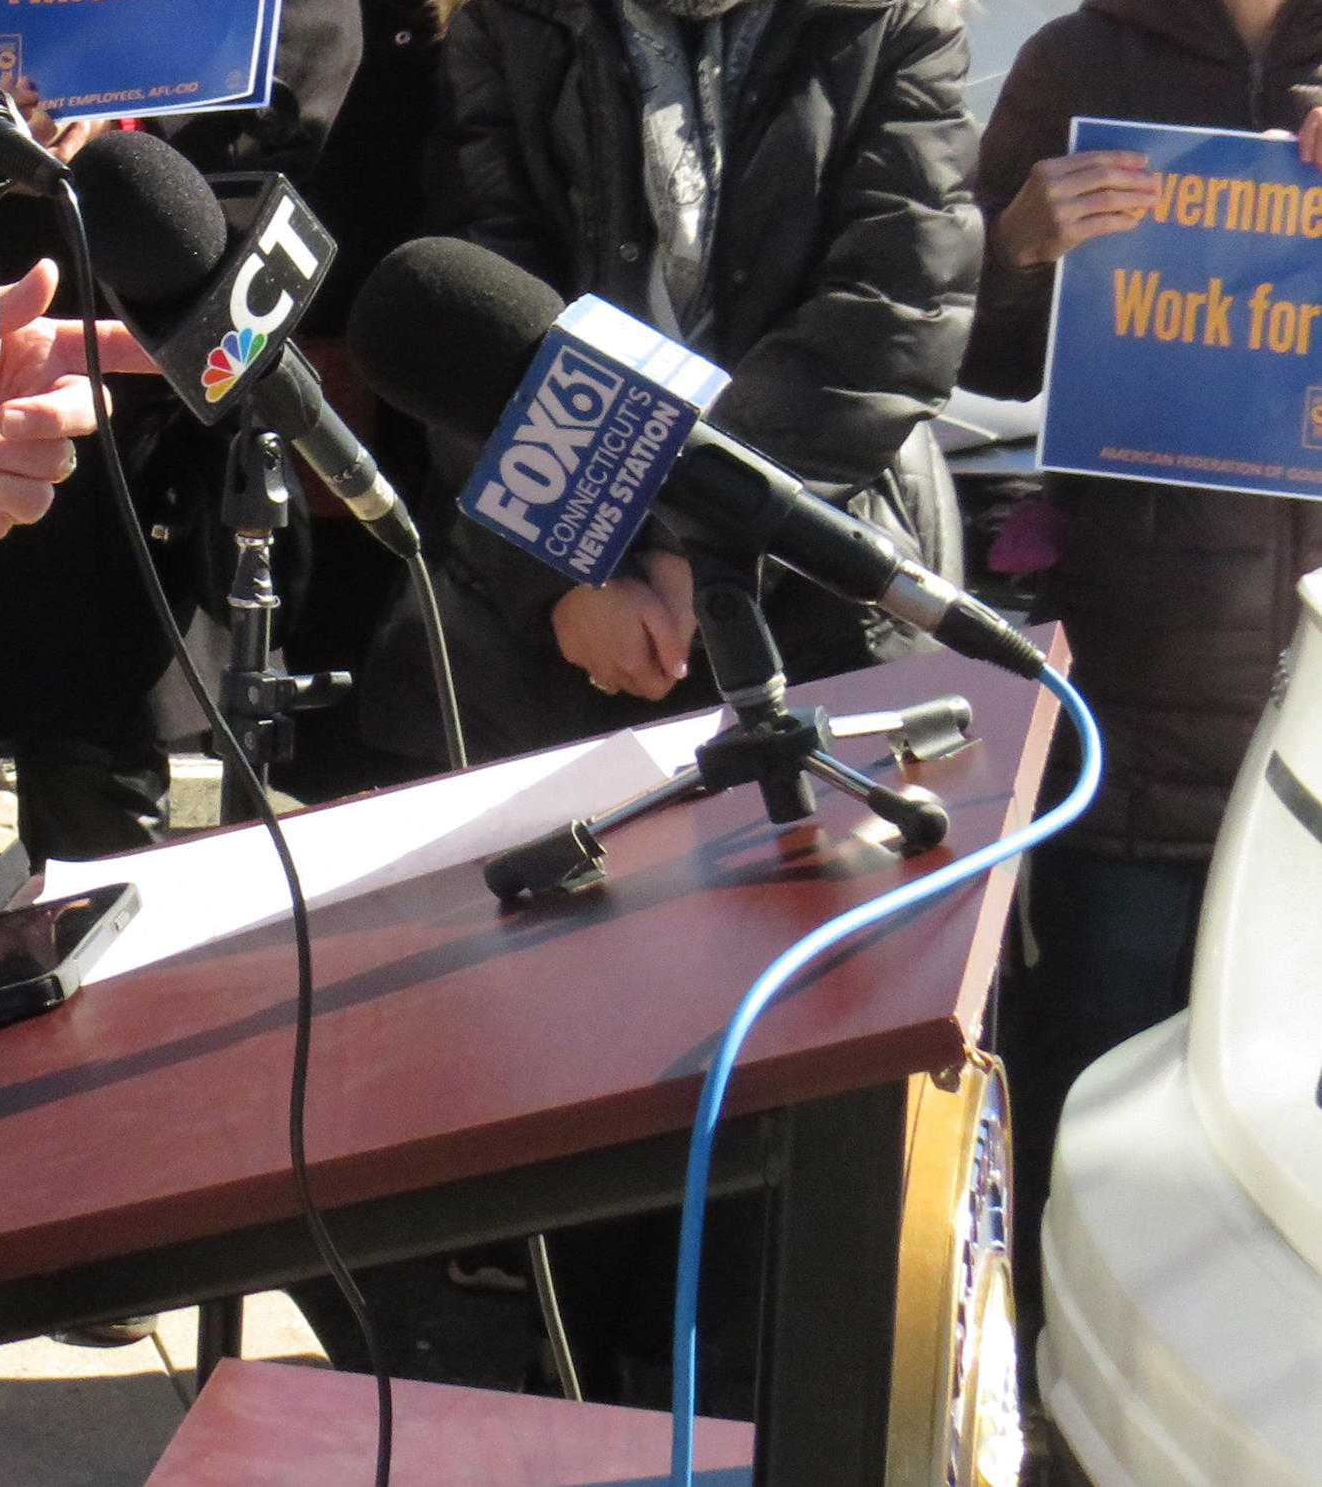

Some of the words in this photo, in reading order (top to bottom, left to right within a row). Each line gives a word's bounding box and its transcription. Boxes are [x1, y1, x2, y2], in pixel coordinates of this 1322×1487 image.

[67, 87, 146, 109] EMPLOYEES,
[148, 80, 200, 99] AFL-CIO
[228, 194, 319, 334] CT
[1114, 268, 1234, 347] Work
[1248, 283, 1321, 355] for
[545, 385, 652, 558] CONNECTICUT'S
[568, 502, 625, 575] NEWS
[609, 400, 681, 505] STATION
